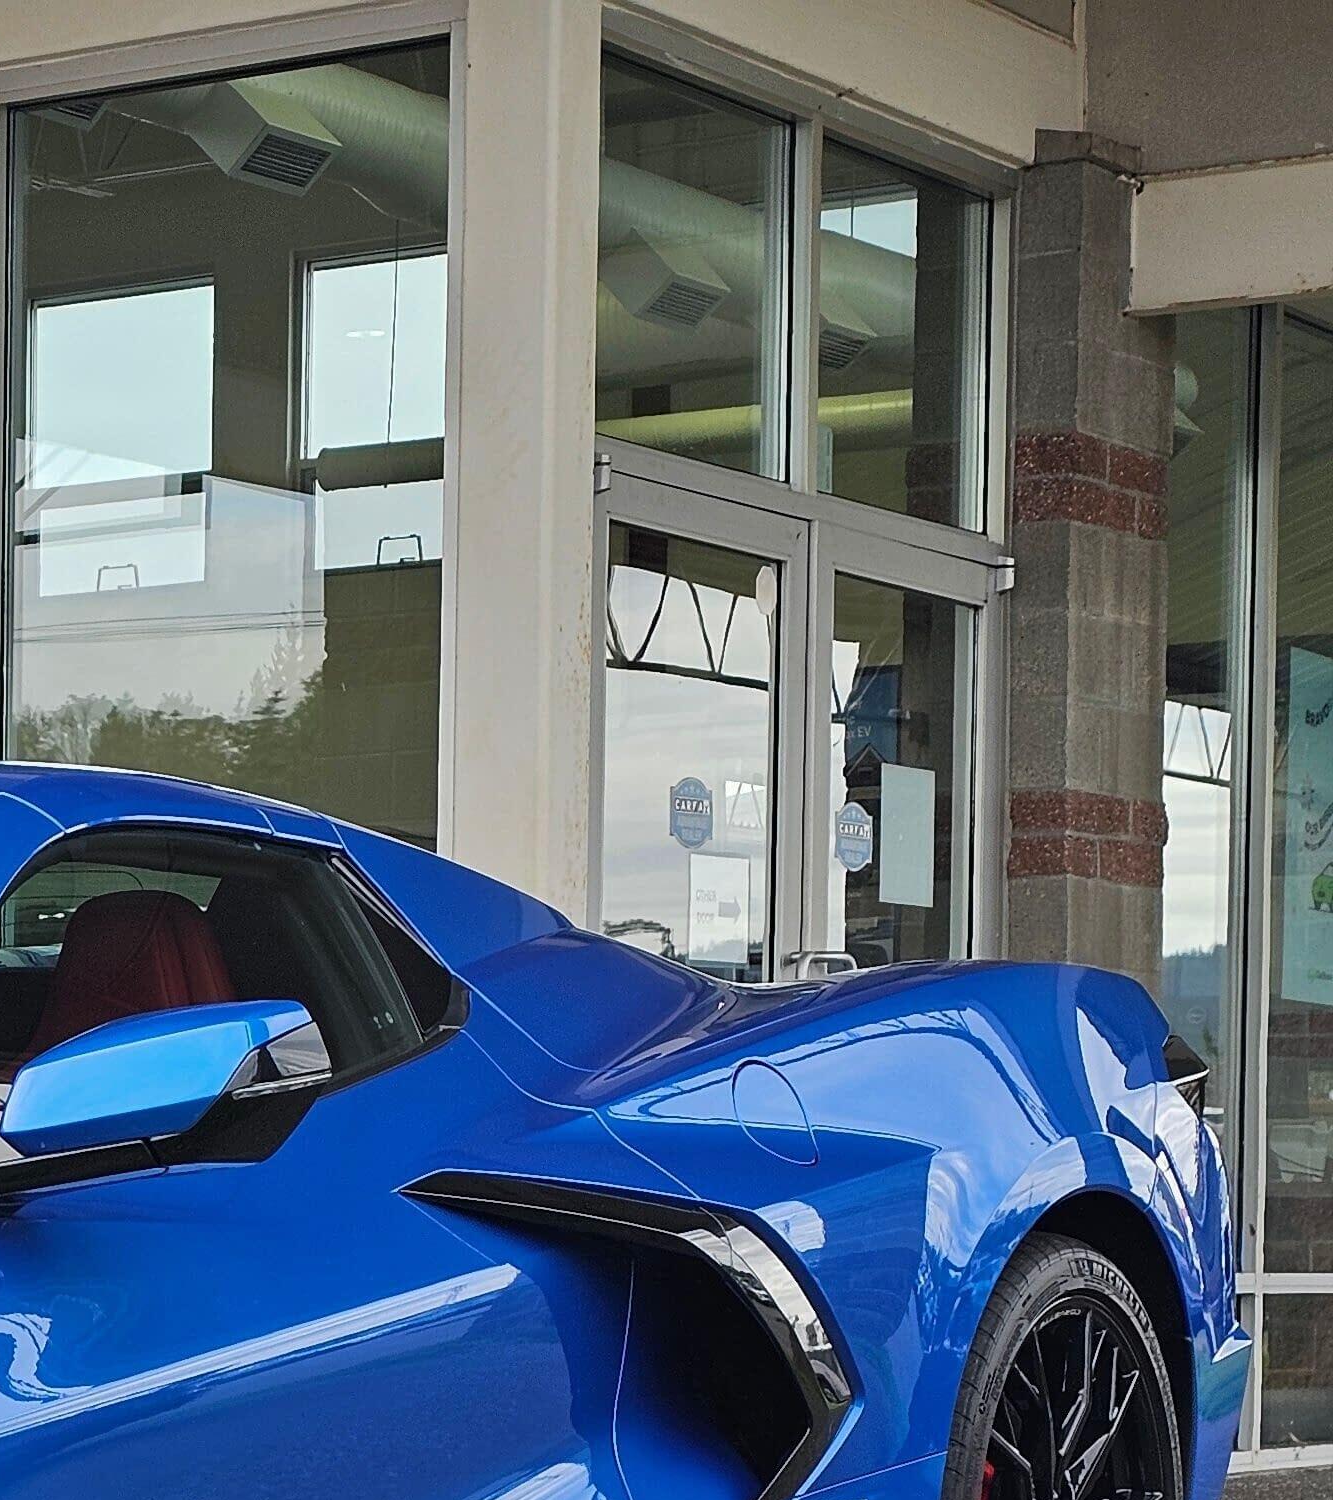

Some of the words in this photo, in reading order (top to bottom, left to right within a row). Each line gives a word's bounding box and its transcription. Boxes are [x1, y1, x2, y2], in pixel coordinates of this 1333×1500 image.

[675, 798, 710, 815] CARFAX
[839, 823, 871, 839] CARFAX
[1092, 1261, 1148, 1327] MICHELIN
